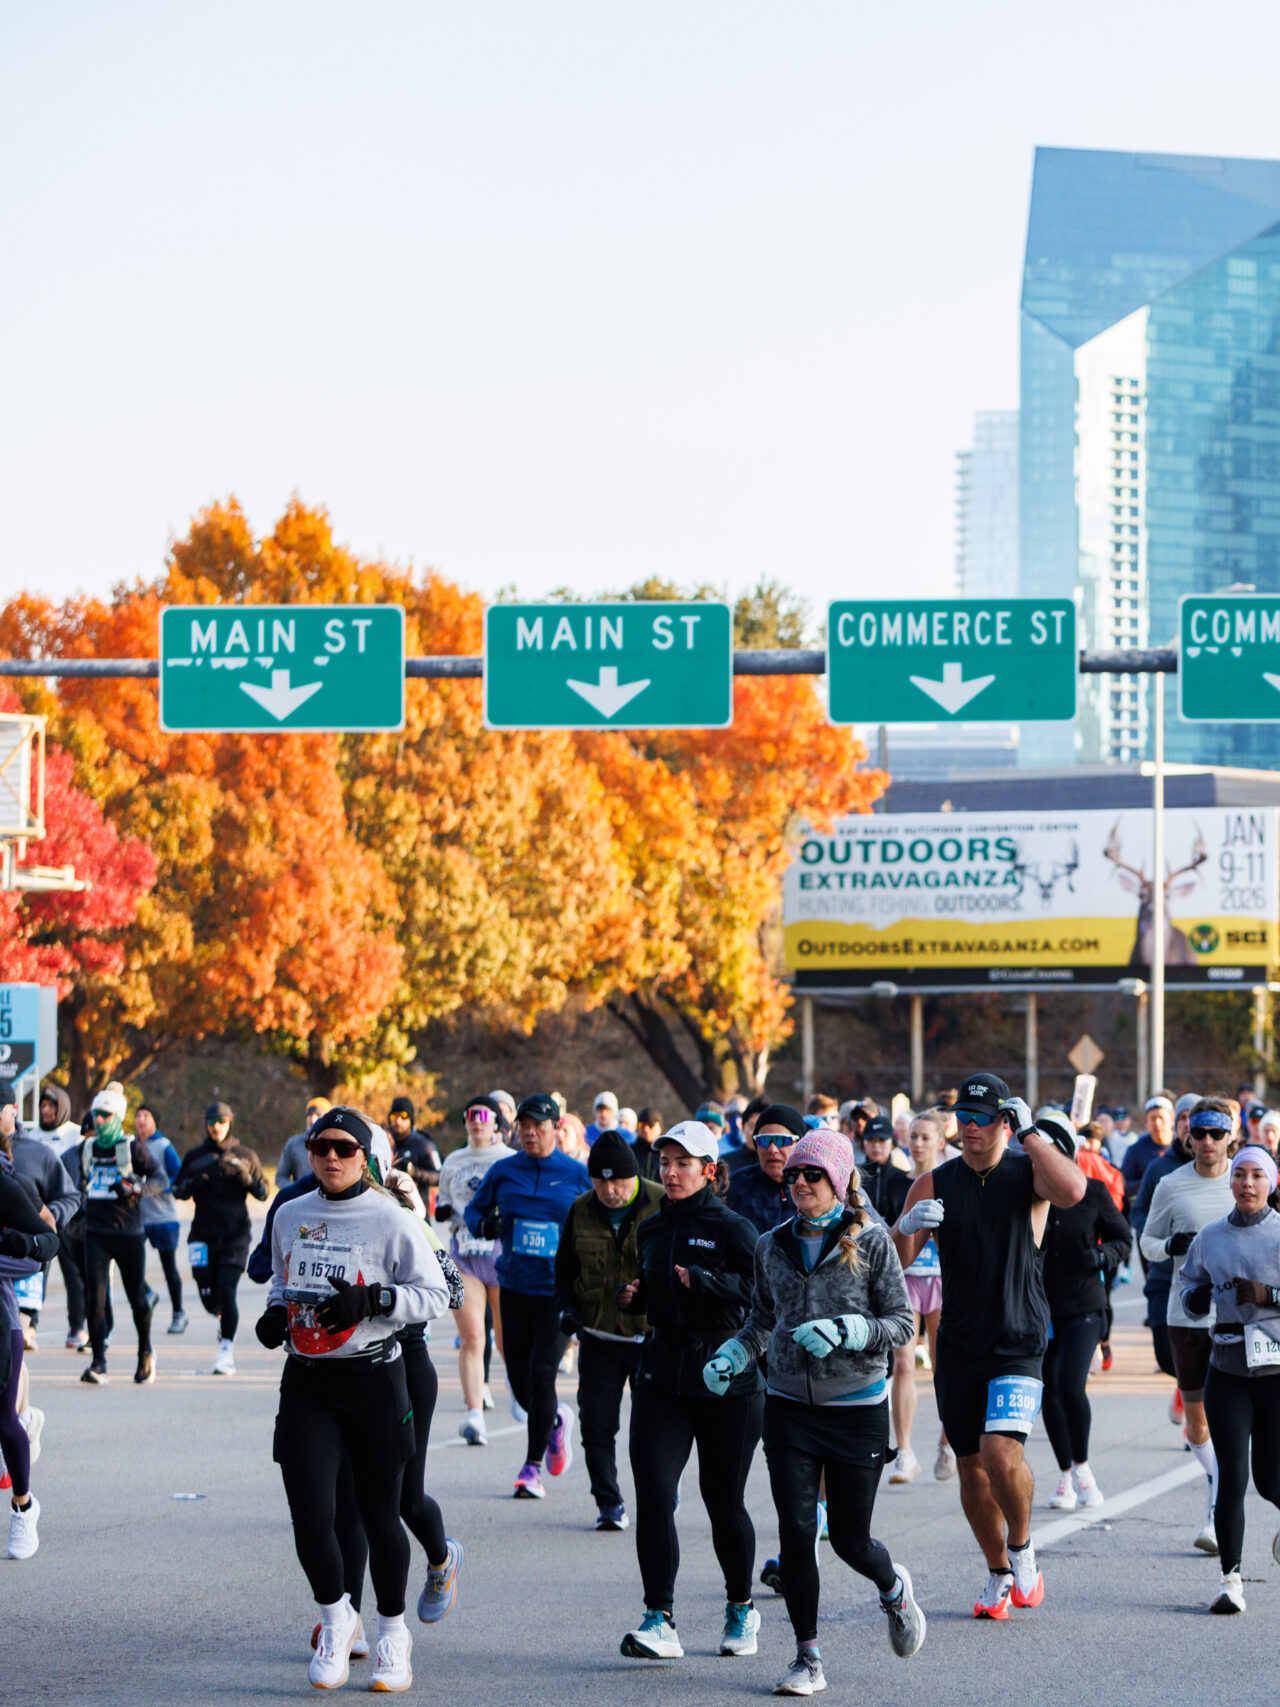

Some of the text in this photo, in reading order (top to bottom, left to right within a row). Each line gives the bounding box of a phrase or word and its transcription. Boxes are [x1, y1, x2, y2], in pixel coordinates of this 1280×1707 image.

[191, 619, 372, 653] MAIN ST
[517, 615, 700, 650] MAIN ST
[837, 610, 1066, 646] COMMERCE ST
[1221, 814, 1265, 847] JAN
[801, 838, 1016, 864] OUTDOORS
[1219, 850, 1265, 884] 9-11
[800, 869, 1018, 891] EXTRAVAGANZA
[1220, 887, 1266, 911] 2026
[529, 1236, 545, 1248] 301
[298, 1262, 346, 1279] B 15710
[1254, 1341, 1261, 1354] B
[997, 1395, 1004, 1408] B
